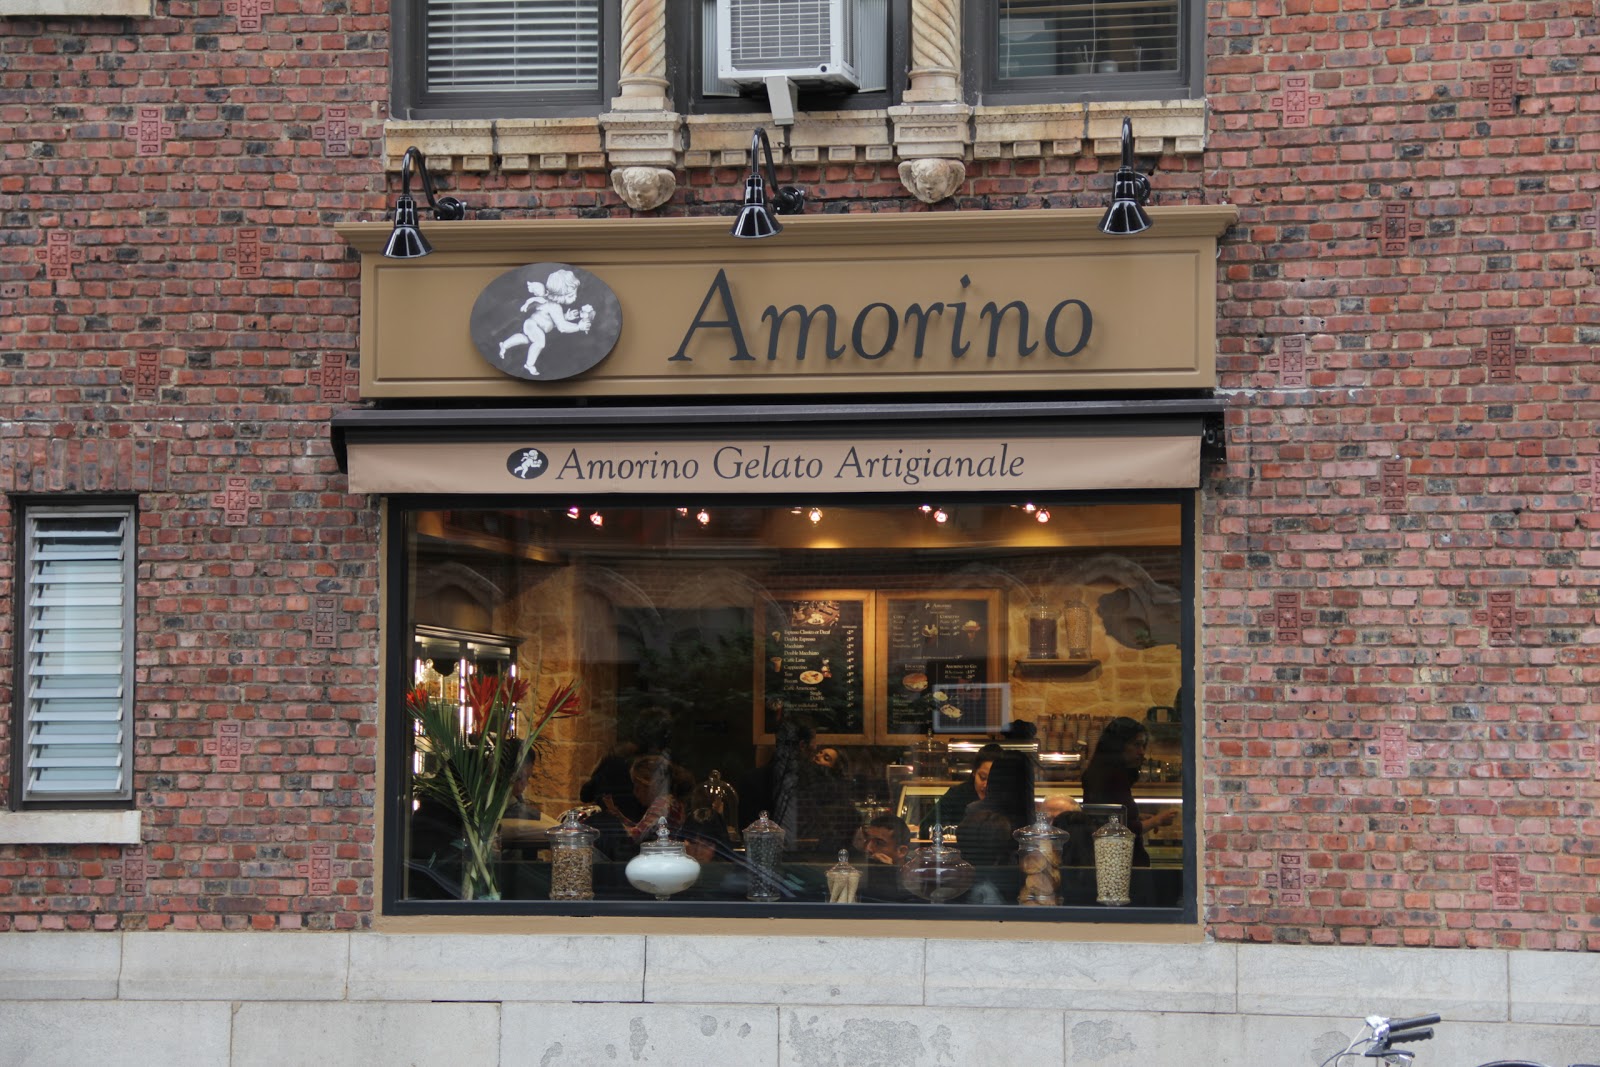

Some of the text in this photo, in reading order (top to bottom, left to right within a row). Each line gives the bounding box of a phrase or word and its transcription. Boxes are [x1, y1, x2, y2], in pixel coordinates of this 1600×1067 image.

[668, 267, 1094, 362] Amorino
[555, 442, 1025, 485] Amorino Gelato Artigianale
